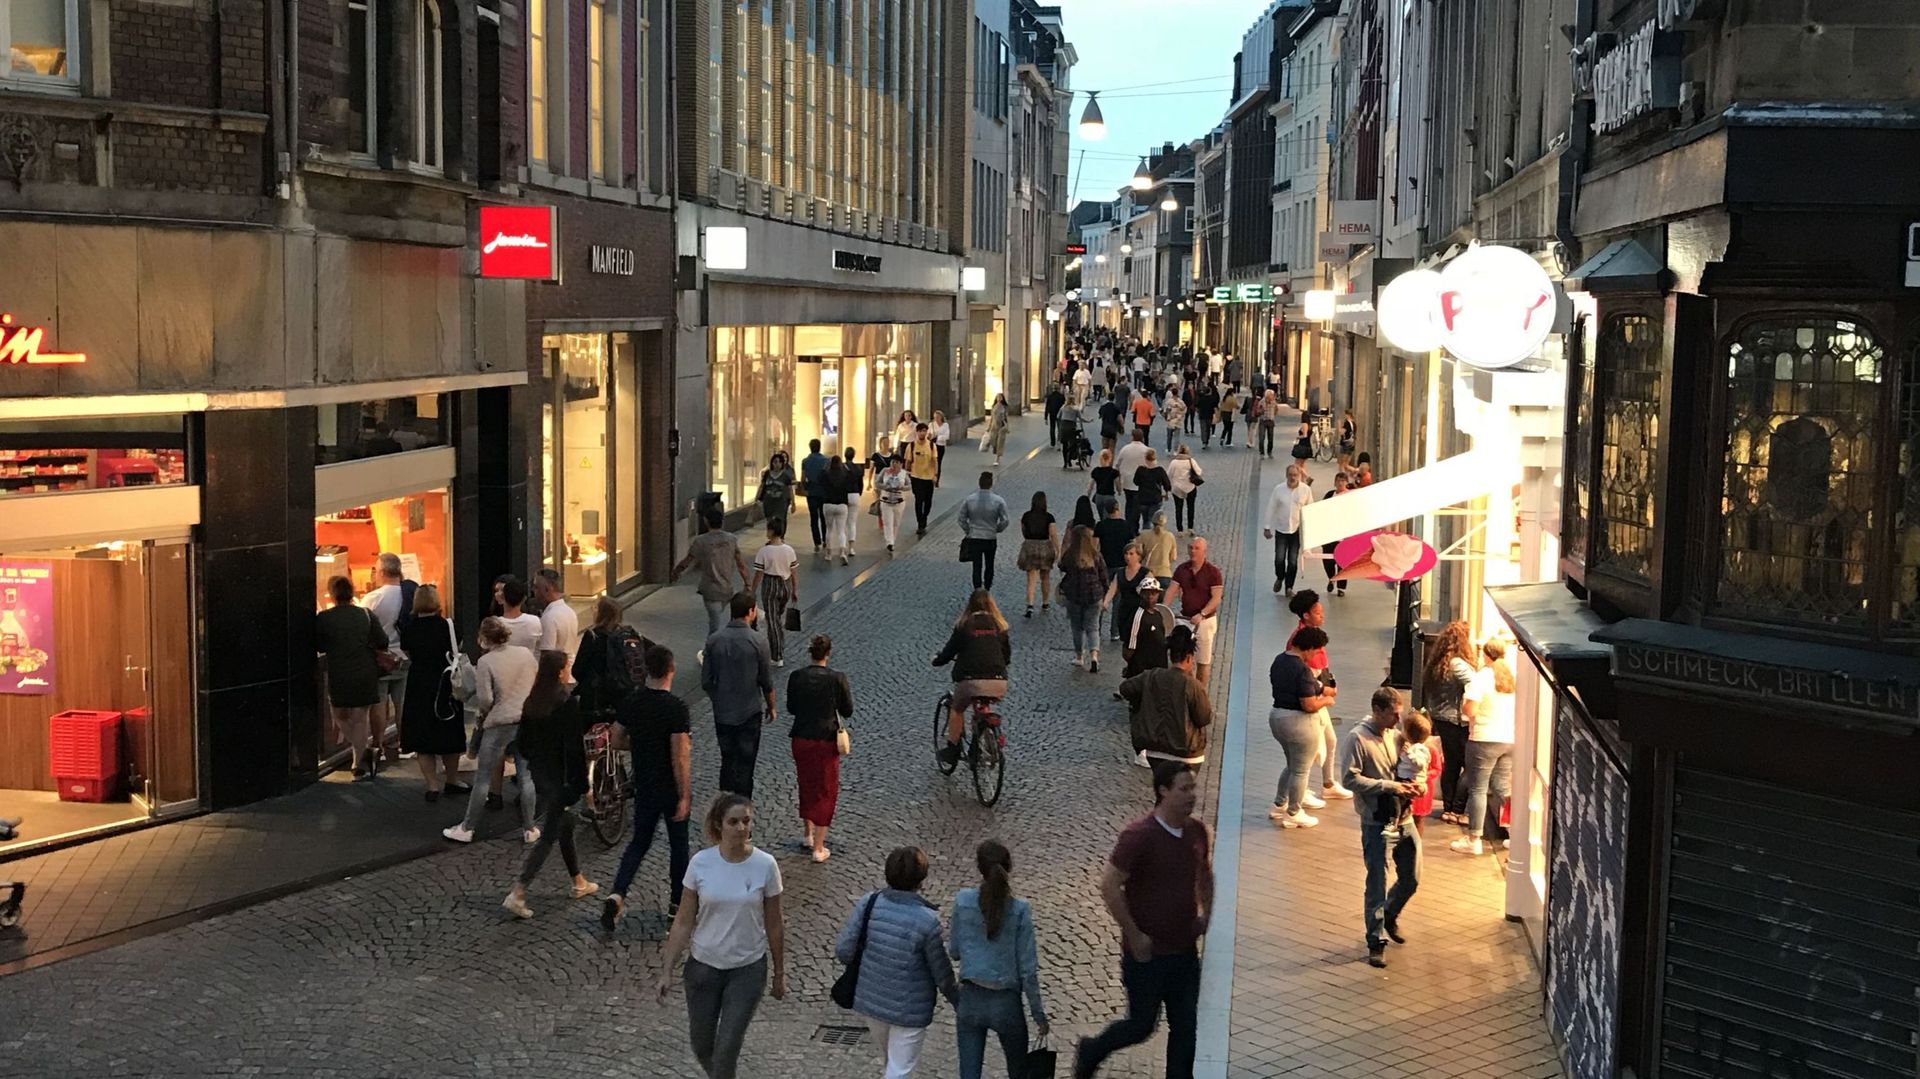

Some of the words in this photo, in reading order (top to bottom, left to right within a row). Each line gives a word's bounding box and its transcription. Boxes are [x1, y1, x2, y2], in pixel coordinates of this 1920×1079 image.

[1338, 223, 1371, 233] HEMA
[592, 245, 635, 276] MANFIELD
[1627, 647, 1758, 689] SCHMECK
